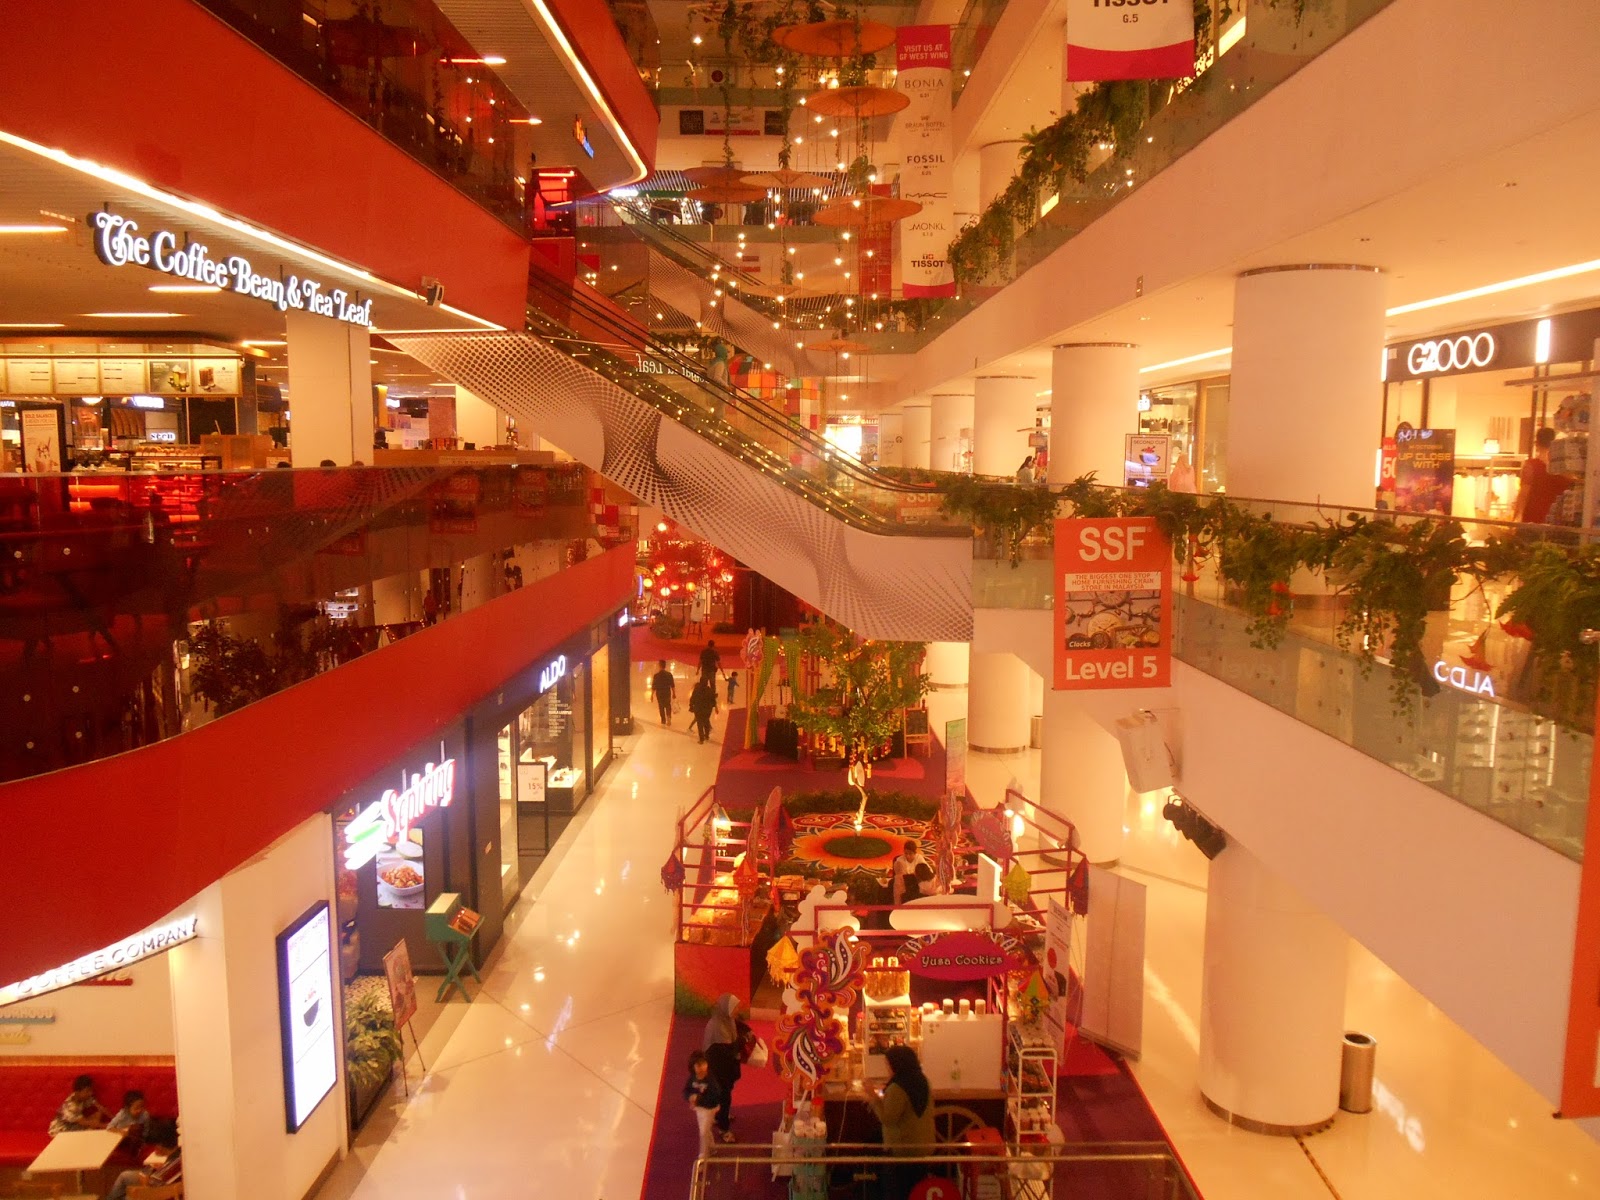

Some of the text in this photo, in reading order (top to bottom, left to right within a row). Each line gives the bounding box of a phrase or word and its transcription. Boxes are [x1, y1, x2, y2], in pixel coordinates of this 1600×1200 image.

[1122, 13, 1139, 23] G.5
[903, 44, 921, 52] VISIT
[934, 43, 943, 51] AT
[909, 52, 928, 60] WEST
[930, 51, 948, 59] WING
[904, 78, 944, 89] BONIA
[906, 154, 945, 164] FOSSIL
[908, 222, 946, 231] MONKI
[96, 212, 149, 266] The
[153, 231, 228, 287] Coffee
[228, 256, 287, 311] Bean
[287, 275, 304, 310] &
[303, 279, 334, 317] Tea
[910, 260, 945, 268] TISSOT
[1407, 332, 1495, 375] G2000
[1398, 452, 1452, 461] UP CLOSE
[1412, 461, 1440, 469] WITH
[1078, 526, 1147, 562] SSF
[1066, 655, 1157, 680] Level 5
[540, 654, 566, 693] ALDO
[528, 782, 543, 790] 15%
[922, 954, 1003, 968] Yusa Cookies
